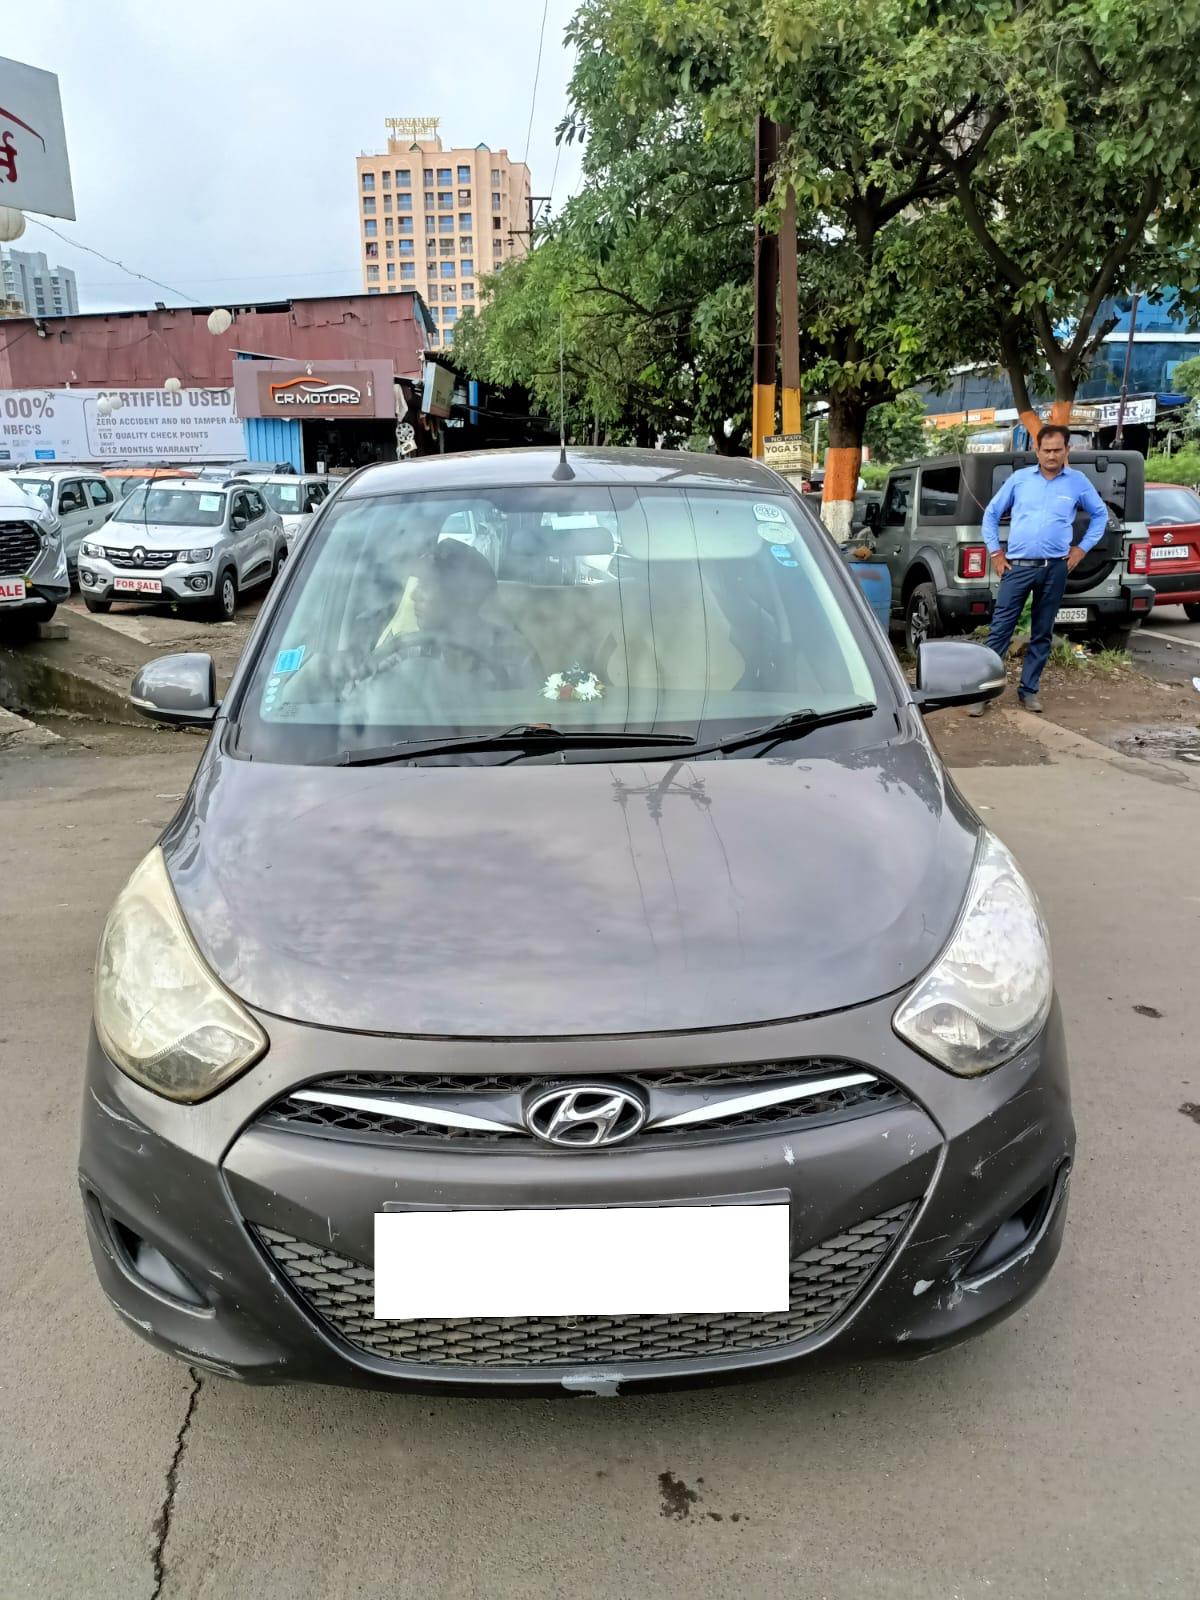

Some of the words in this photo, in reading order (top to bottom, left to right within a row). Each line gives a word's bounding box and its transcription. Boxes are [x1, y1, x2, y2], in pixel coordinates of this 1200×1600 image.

[189, 391, 231, 406] USED
[97, 417, 117, 426] ZERO
[119, 417, 159, 425] ACCIDENT
[161, 416, 178, 425] AND
[180, 416, 191, 425] NO
[194, 416, 227, 425] TAMPER
[3, 425, 42, 435] NBFC'S
[99, 432, 113, 440] 167
[115, 432, 148, 440] QUALITY
[150, 431, 178, 440] CHECK
[180, 431, 209, 439] POINTS
[119, 446, 153, 454] MONTHS
[765, 445, 791, 453] YOGA
[0, 584, 23, 596] ALE
[115, 579, 135, 589] FOR
[136, 582, 161, 591] SALE
